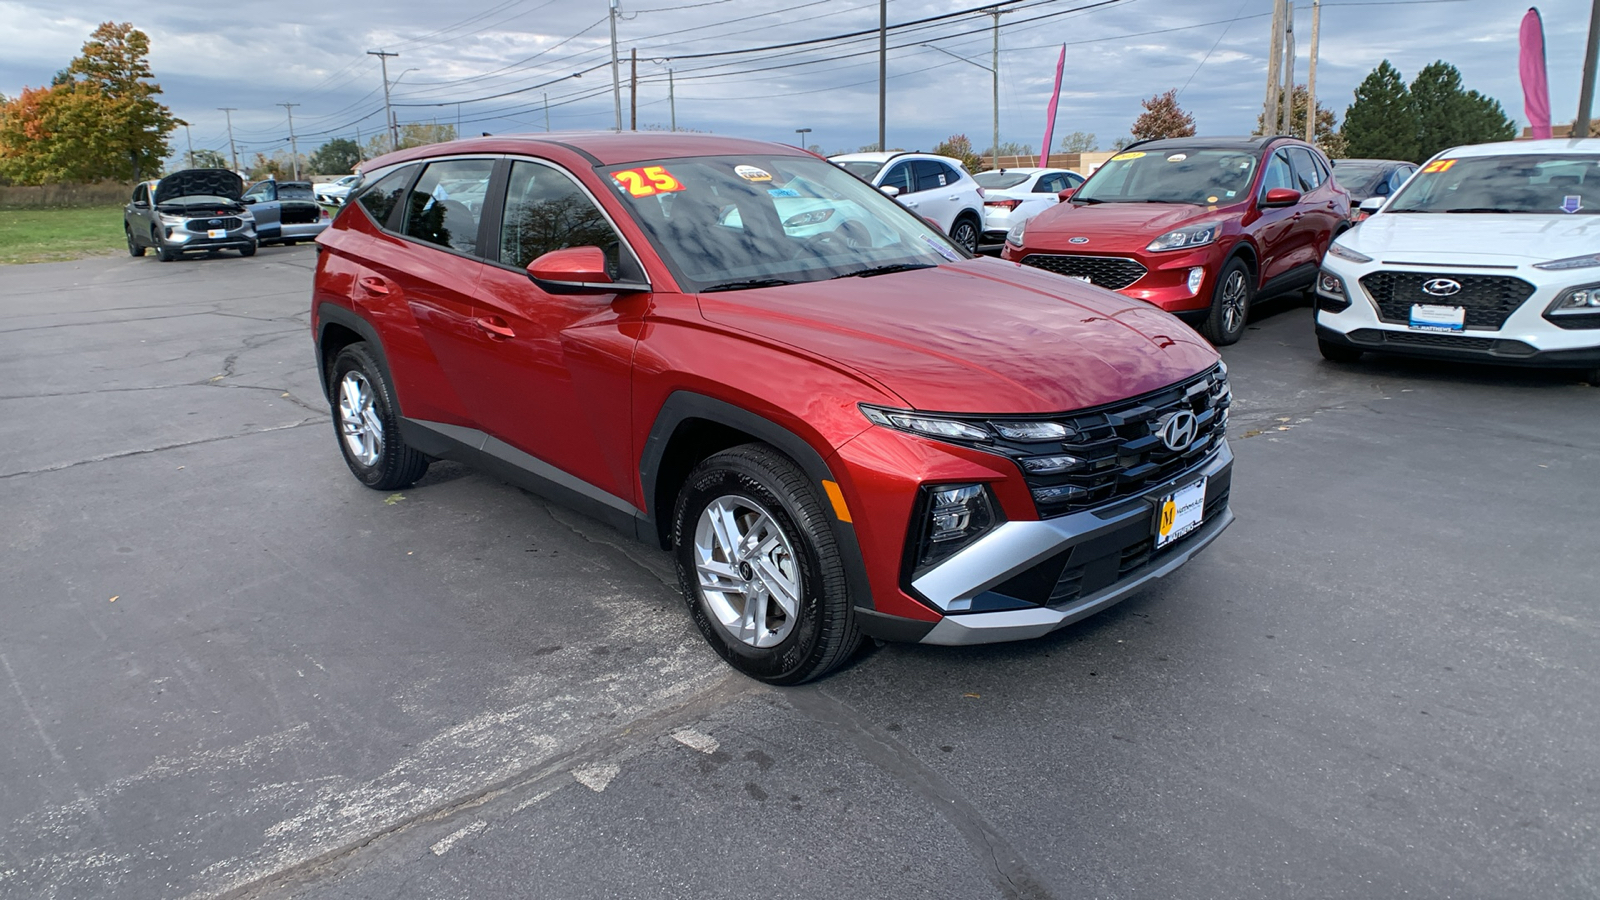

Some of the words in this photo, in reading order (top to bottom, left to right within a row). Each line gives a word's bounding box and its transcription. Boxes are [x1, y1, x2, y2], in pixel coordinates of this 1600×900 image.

[615, 166, 678, 195] 25
[1423, 160, 1456, 172] 21
[675, 497, 688, 546] KUMHO
